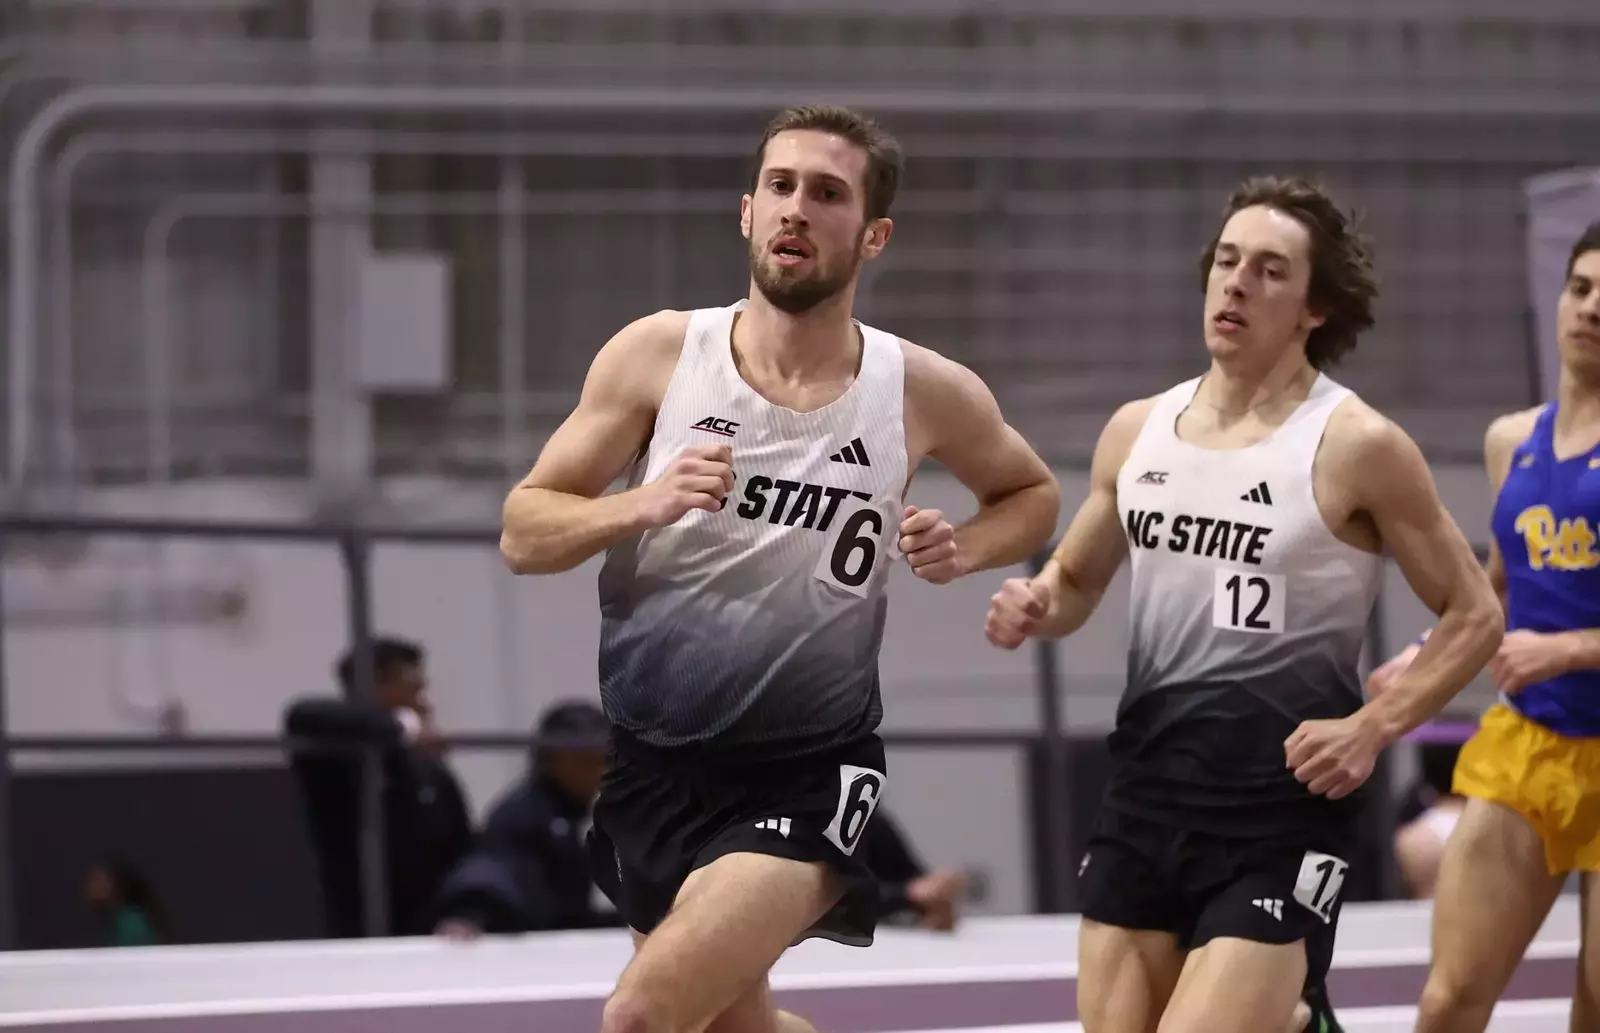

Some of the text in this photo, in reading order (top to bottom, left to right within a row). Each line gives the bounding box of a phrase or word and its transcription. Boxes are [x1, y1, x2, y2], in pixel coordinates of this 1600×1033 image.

[692, 416, 741, 437] ACC
[736, 475, 873, 532] STAT
[1137, 470, 1170, 485] ACC
[830, 508, 882, 587] 6
[1127, 509, 1273, 565] NC STATE
[1225, 574, 1271, 629] 12
[839, 772, 880, 849] 6
